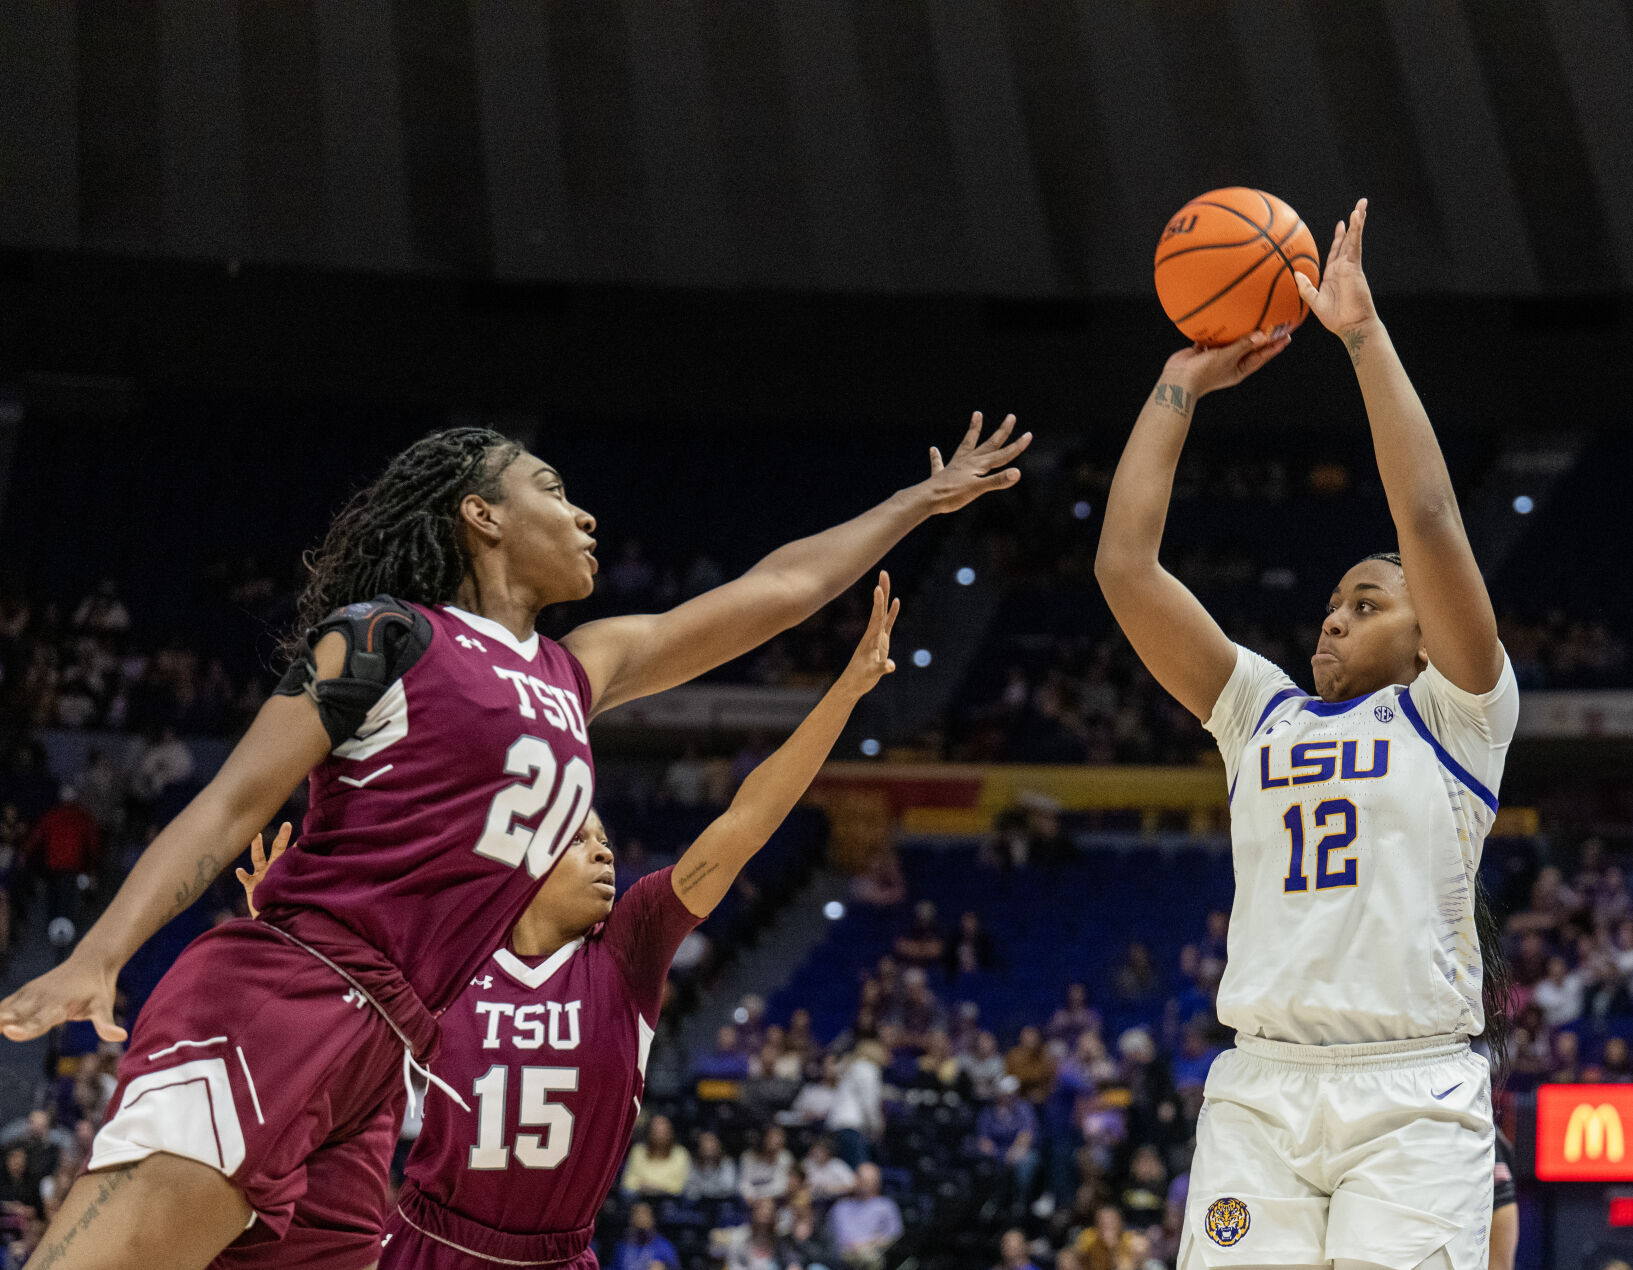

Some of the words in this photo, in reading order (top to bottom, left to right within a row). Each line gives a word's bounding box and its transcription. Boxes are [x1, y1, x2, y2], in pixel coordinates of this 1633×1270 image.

[492, 665, 588, 745] TSU
[1374, 705, 1393, 722] SEC
[1260, 738, 1390, 791] LSU
[472, 733, 593, 881] 20
[1283, 797, 1359, 894] 12
[475, 1000, 581, 1050] TSU
[468, 1064, 579, 1170] 15
